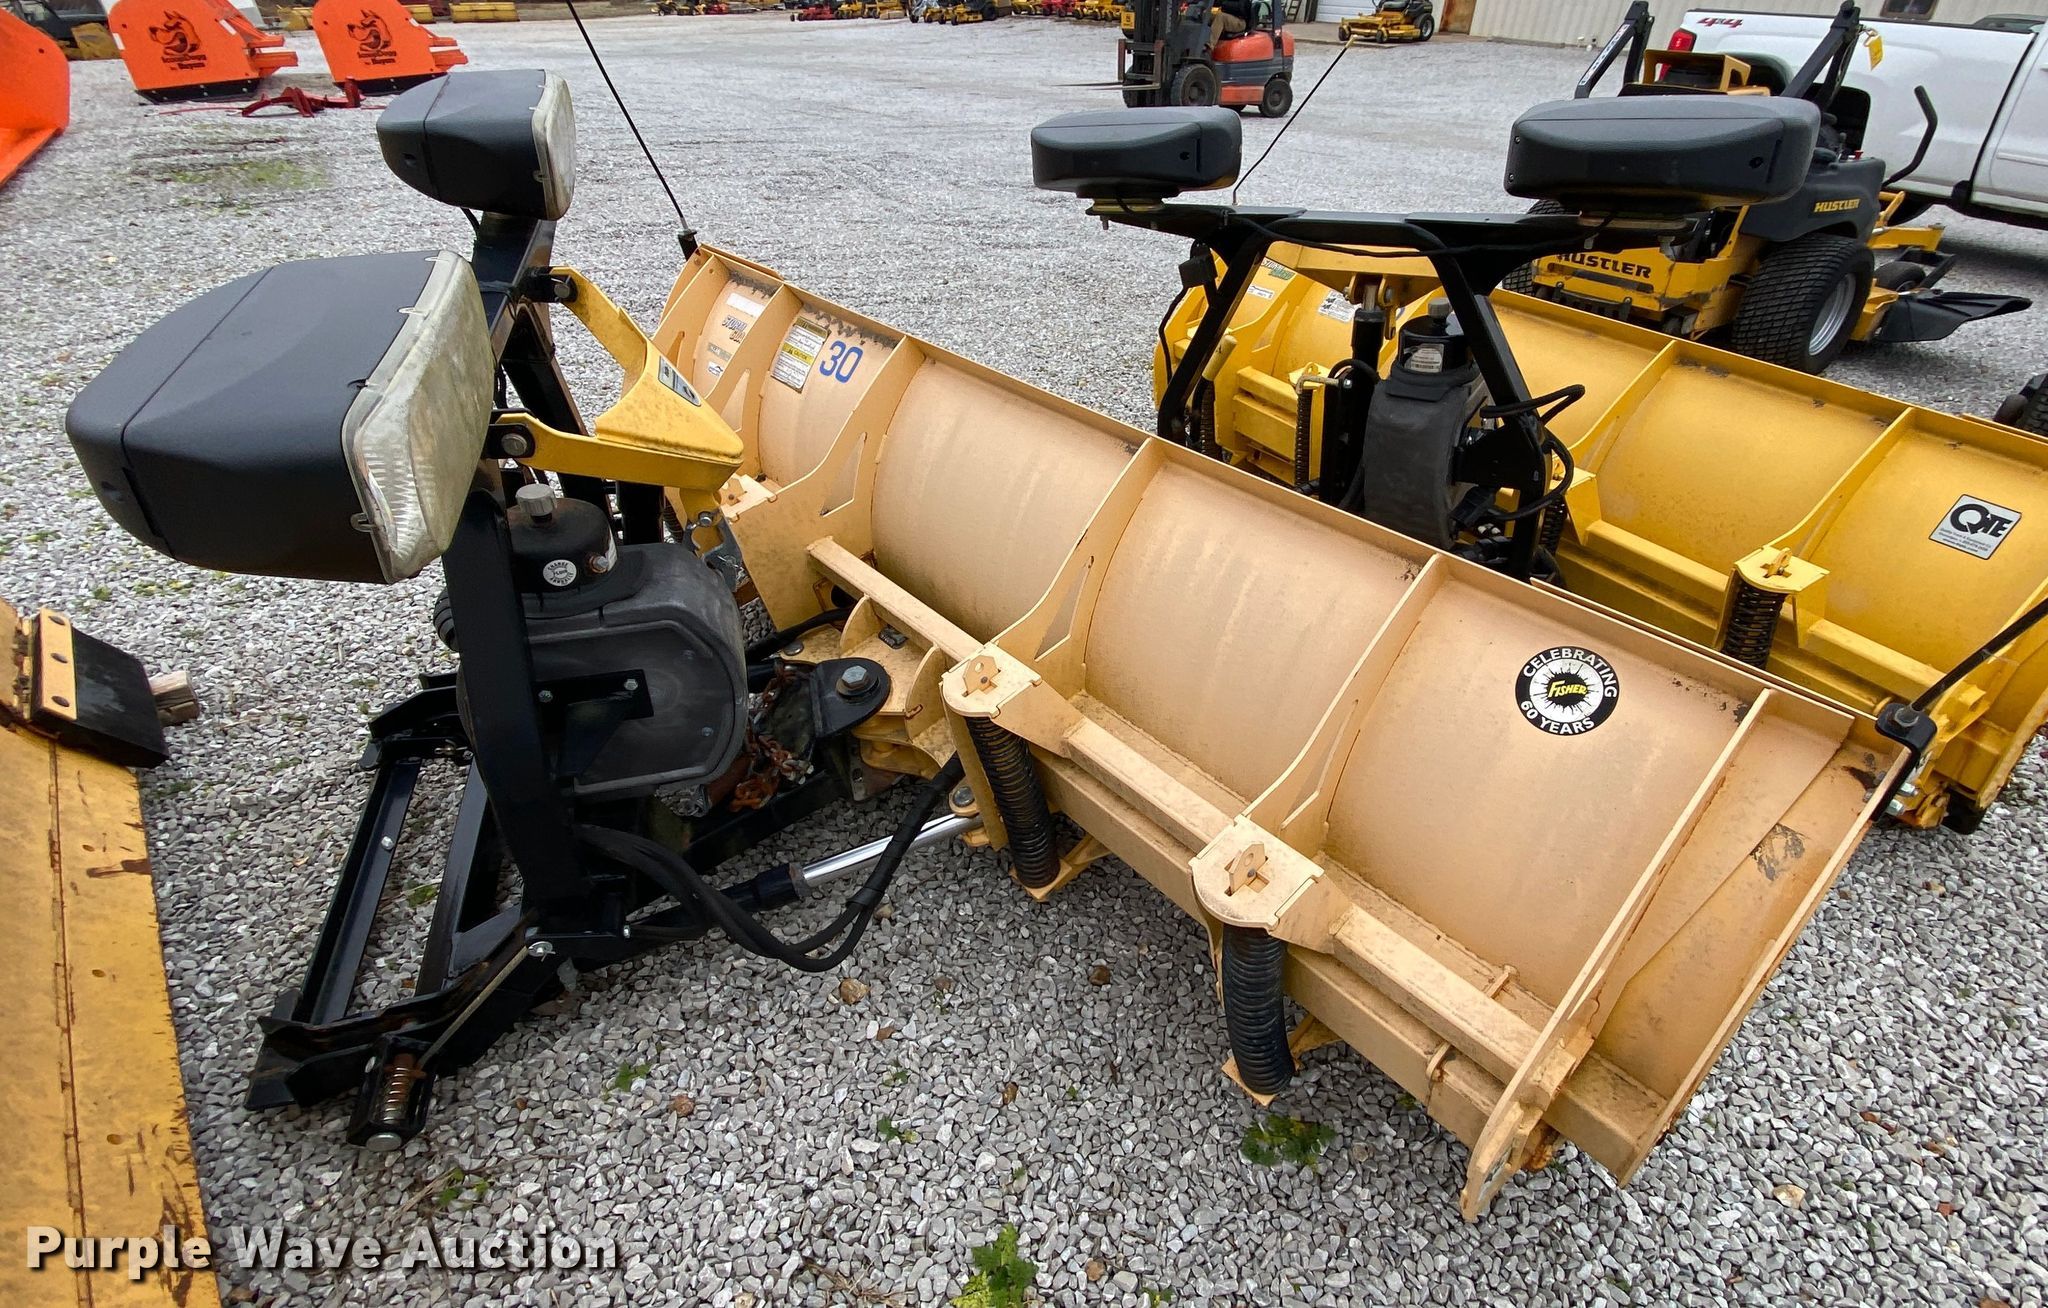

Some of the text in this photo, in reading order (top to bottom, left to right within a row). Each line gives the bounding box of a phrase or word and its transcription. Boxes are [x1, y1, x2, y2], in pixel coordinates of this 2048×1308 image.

[1814, 198, 1860, 212] HUSTLER
[820, 340, 863, 383] 30
[1523, 648, 1617, 698] CELEBRATING
[1548, 680, 1587, 698] FISHER
[1520, 700, 1595, 735] 60 YEARS
